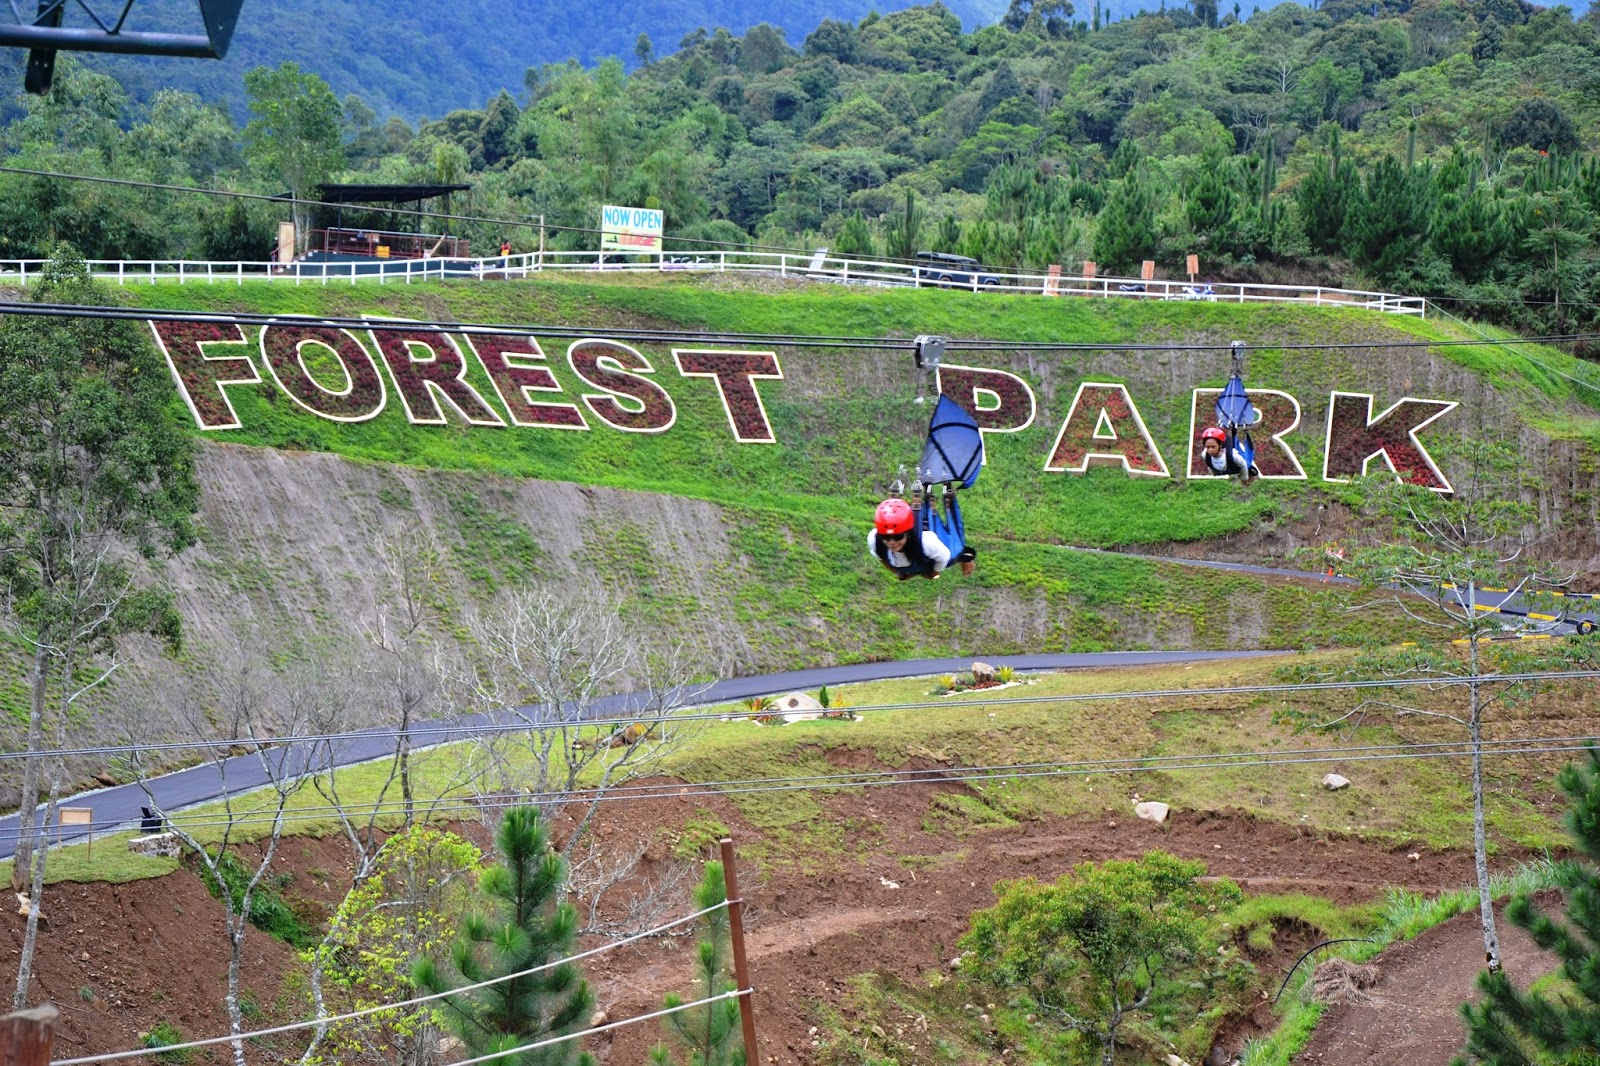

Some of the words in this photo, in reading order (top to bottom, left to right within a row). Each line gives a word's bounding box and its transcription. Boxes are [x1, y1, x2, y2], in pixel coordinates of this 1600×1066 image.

[604, 208, 631, 226] NOW
[633, 210, 661, 228] OPEN
[148, 314, 784, 443] FOREST
[936, 363, 1459, 493] PARK
